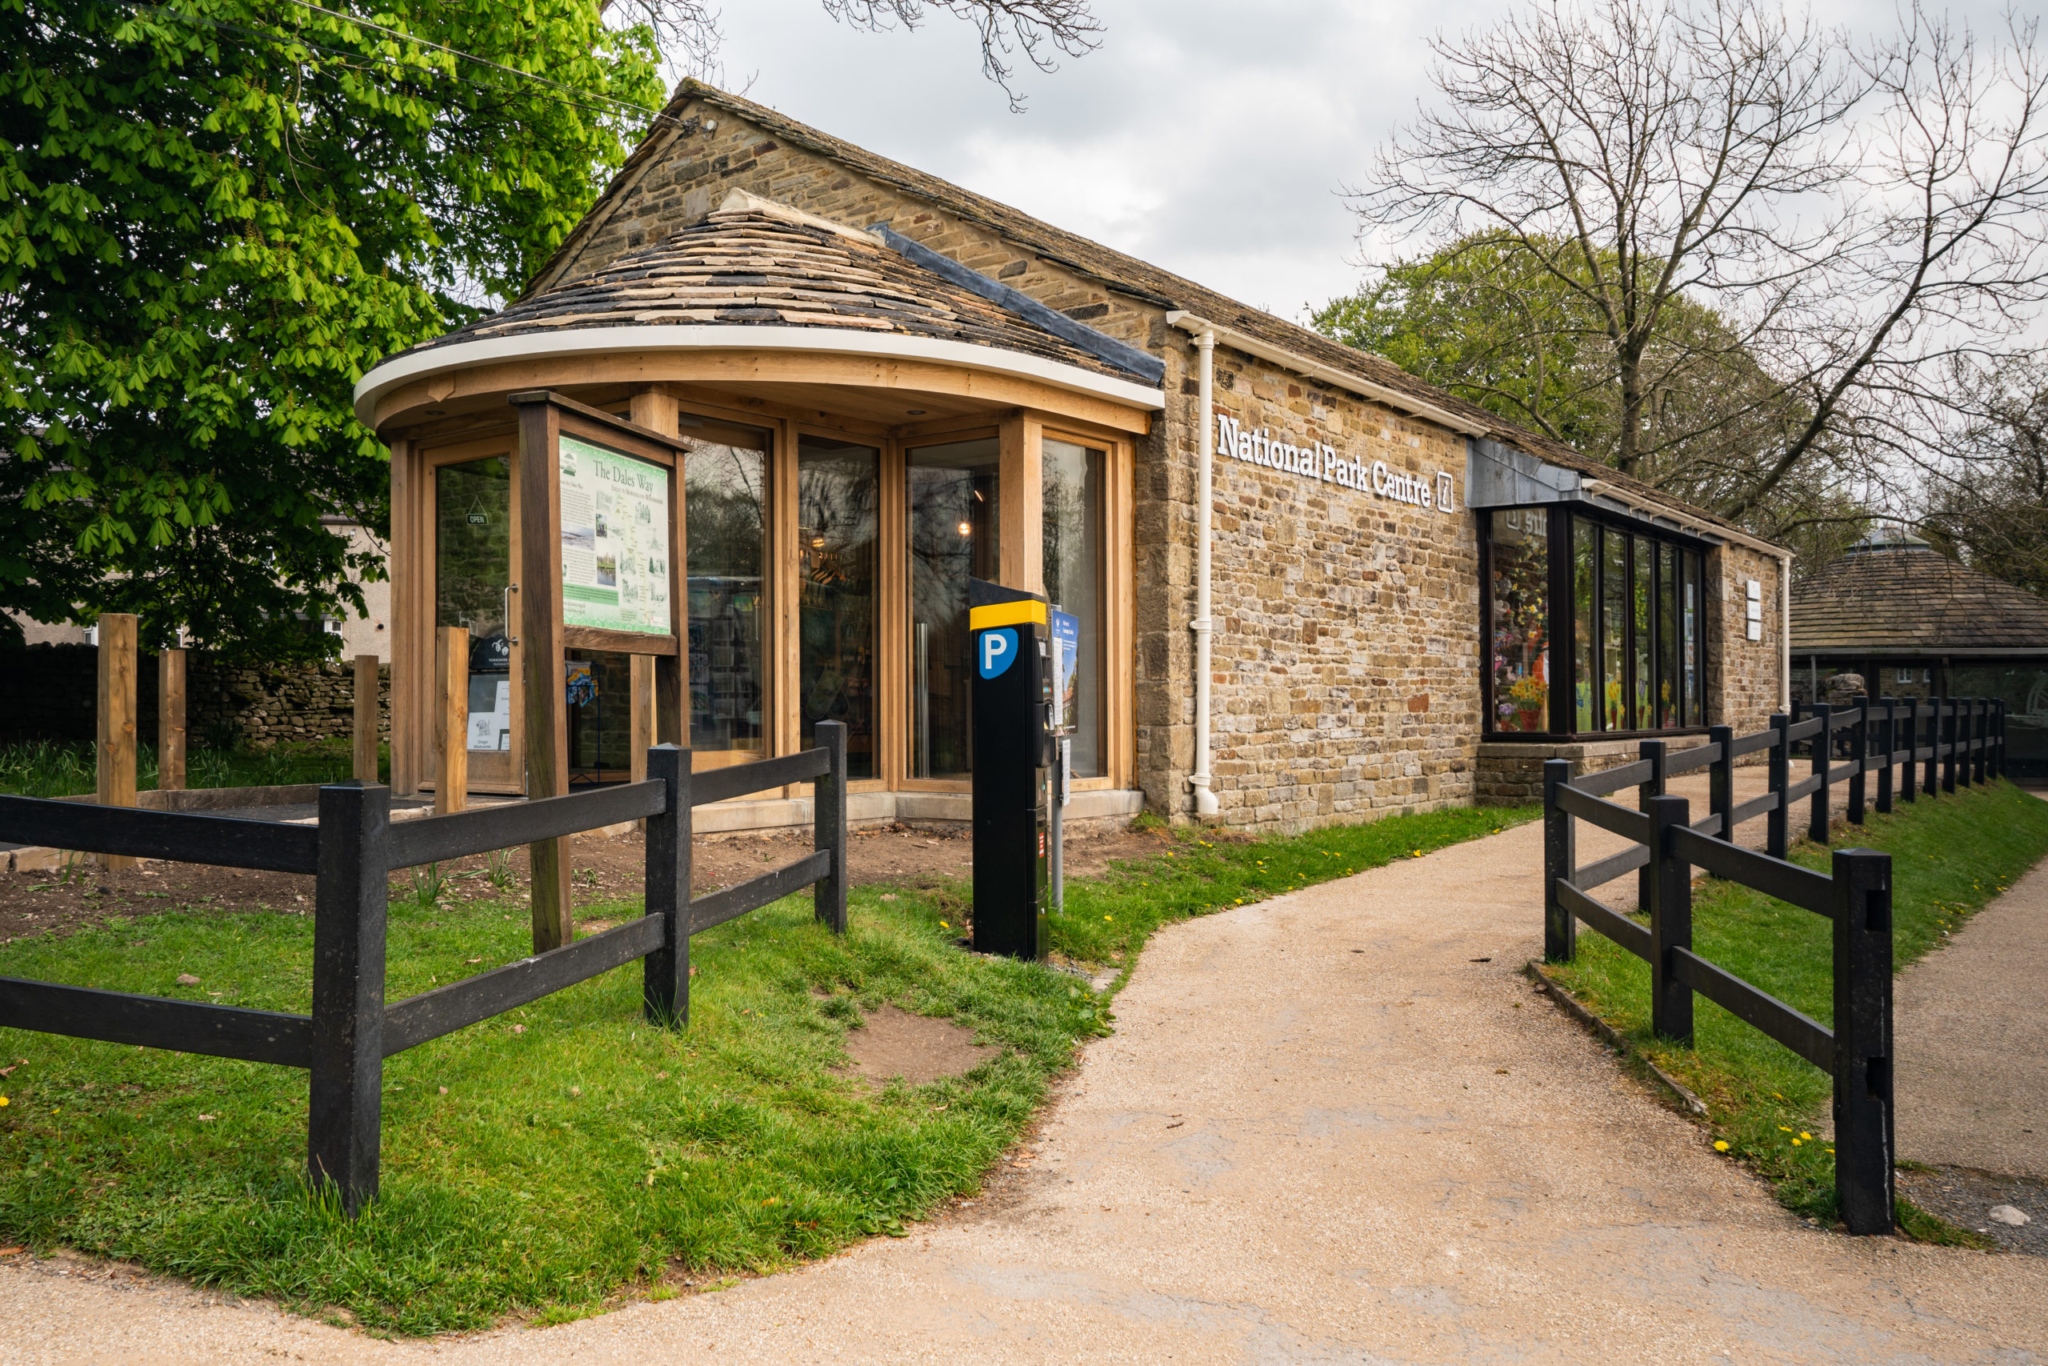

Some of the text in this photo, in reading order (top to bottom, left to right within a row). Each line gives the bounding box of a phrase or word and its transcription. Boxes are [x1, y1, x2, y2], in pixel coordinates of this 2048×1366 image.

[594, 461, 610, 480] The
[612, 466, 636, 487] Dales
[637, 473, 654, 496] Way
[1217, 414, 1430, 508] National Park Centre
[985, 634, 1008, 670] P
